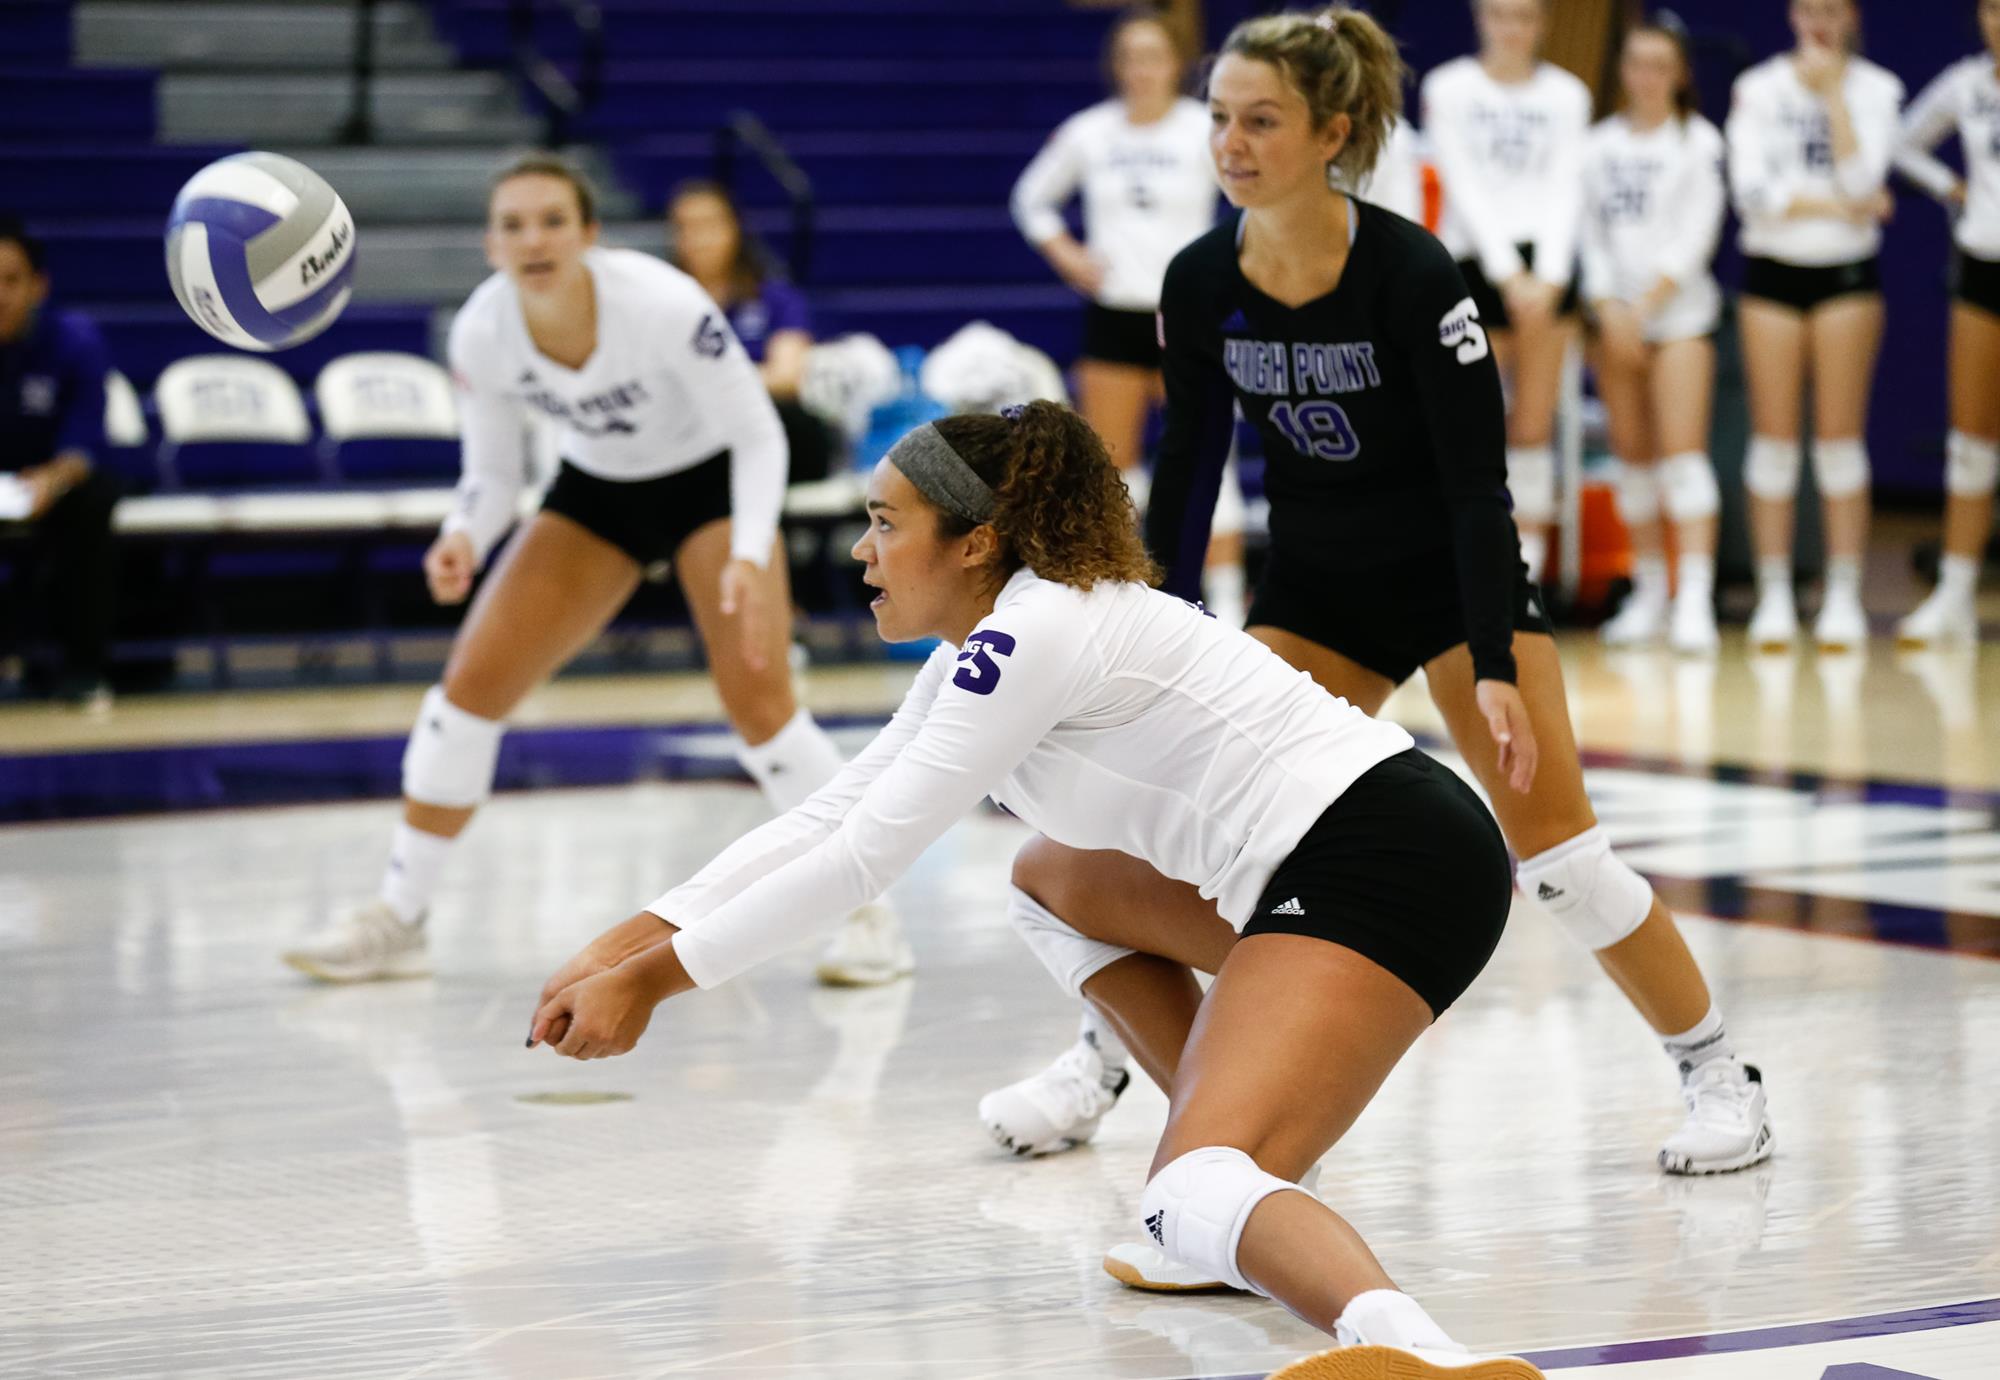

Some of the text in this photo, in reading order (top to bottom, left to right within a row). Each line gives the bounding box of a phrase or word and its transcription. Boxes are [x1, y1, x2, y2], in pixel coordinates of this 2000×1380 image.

[1223, 338, 1381, 396] HIGH POINT
[1268, 401, 1361, 461] 19
